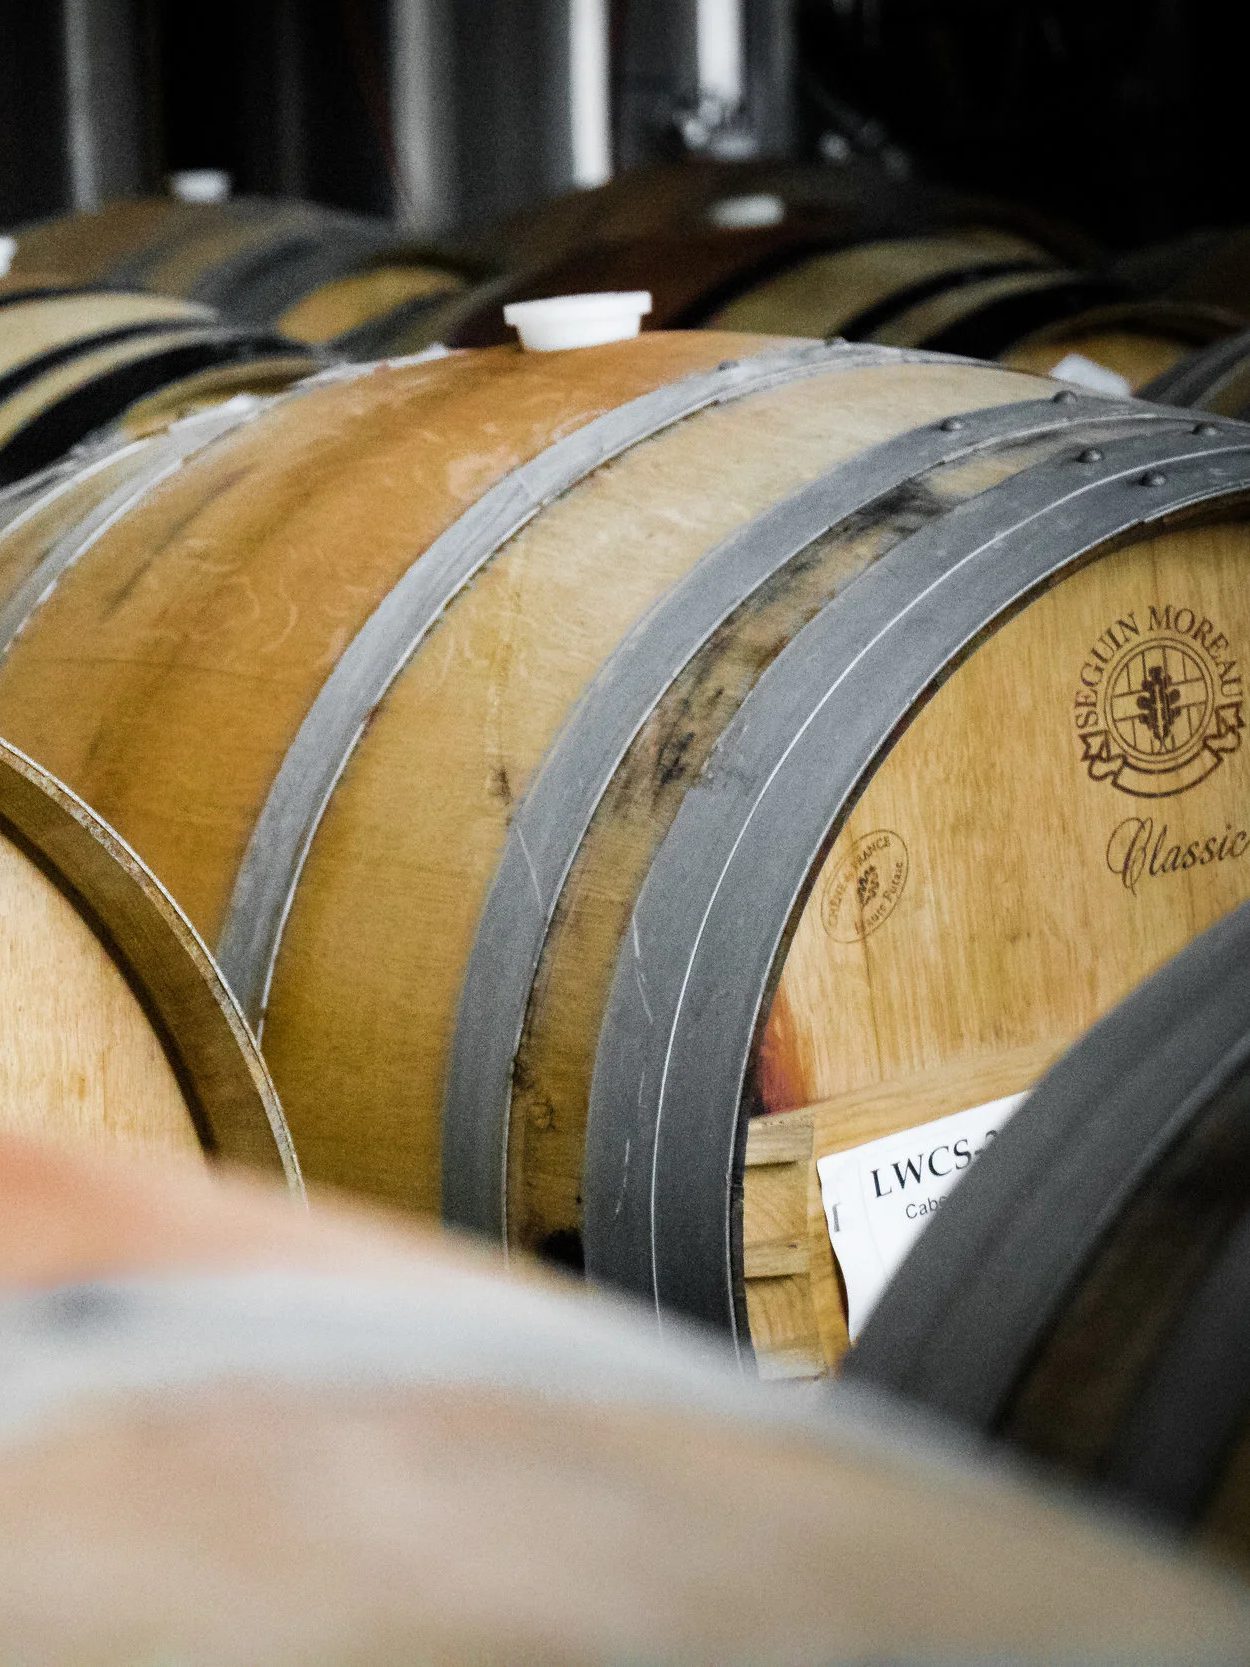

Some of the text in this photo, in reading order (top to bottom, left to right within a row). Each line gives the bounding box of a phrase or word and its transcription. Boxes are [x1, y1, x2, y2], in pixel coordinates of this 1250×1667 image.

[1074, 604, 1244, 730] SEGUIN MOREAU
[1106, 817, 1250, 897] Classic
